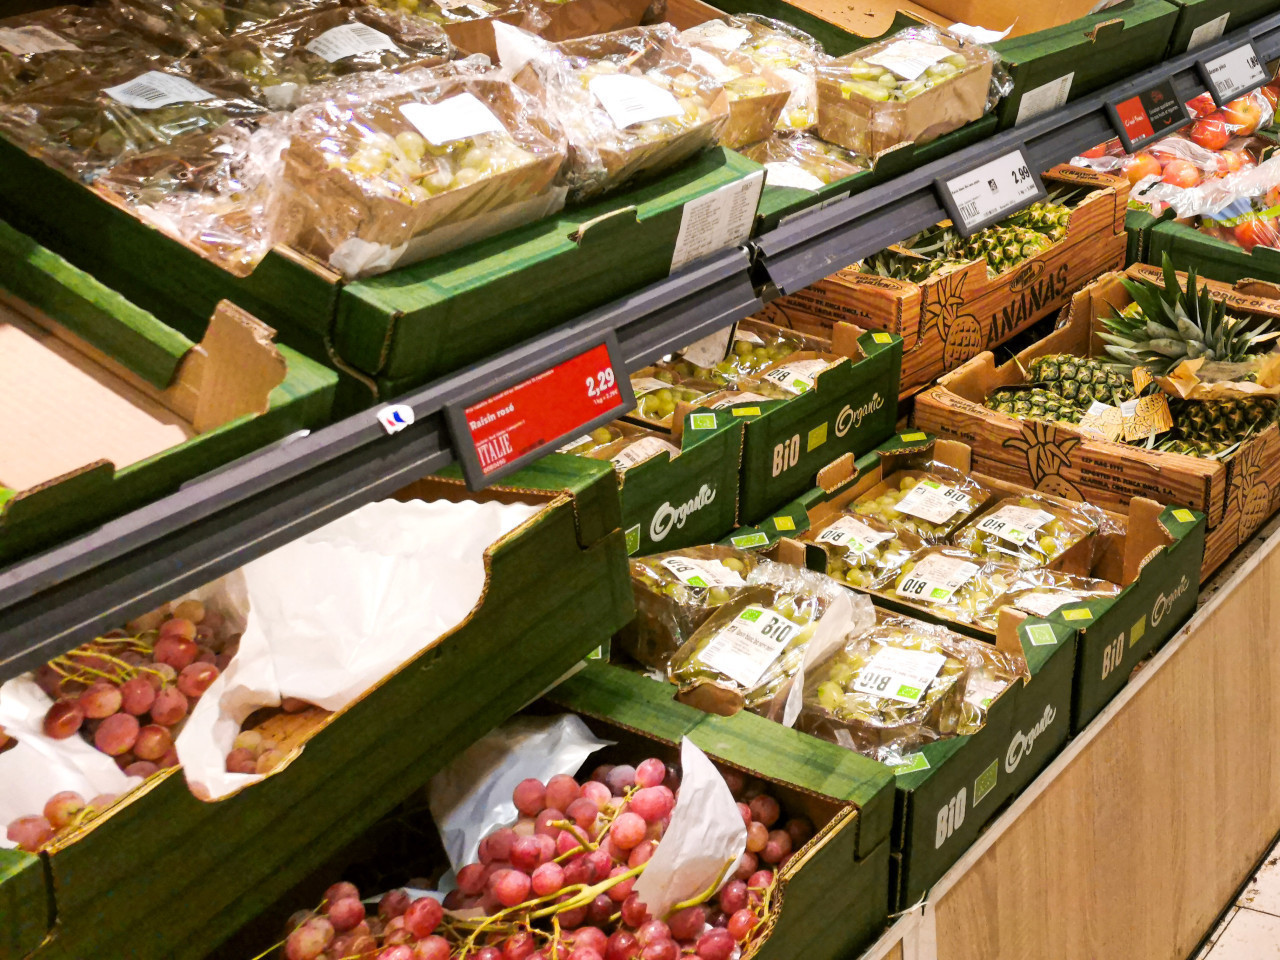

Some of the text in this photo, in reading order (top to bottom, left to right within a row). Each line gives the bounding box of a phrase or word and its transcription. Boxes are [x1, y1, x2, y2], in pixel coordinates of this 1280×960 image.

[1011, 165, 1030, 184] 2,99
[960, 201, 980, 221] ITALIE
[987, 263, 1069, 343] ANANAS
[1203, 289, 1247, 305] RODUCT
[585, 367, 615, 397] 2,29
[469, 402, 515, 431] Raisin rosé
[835, 392, 885, 437] Organic
[477, 433, 513, 466] ITALIE
[650, 483, 716, 542] Organic
[1151, 574, 1190, 627] Organic
[1005, 704, 1057, 773] Organic
